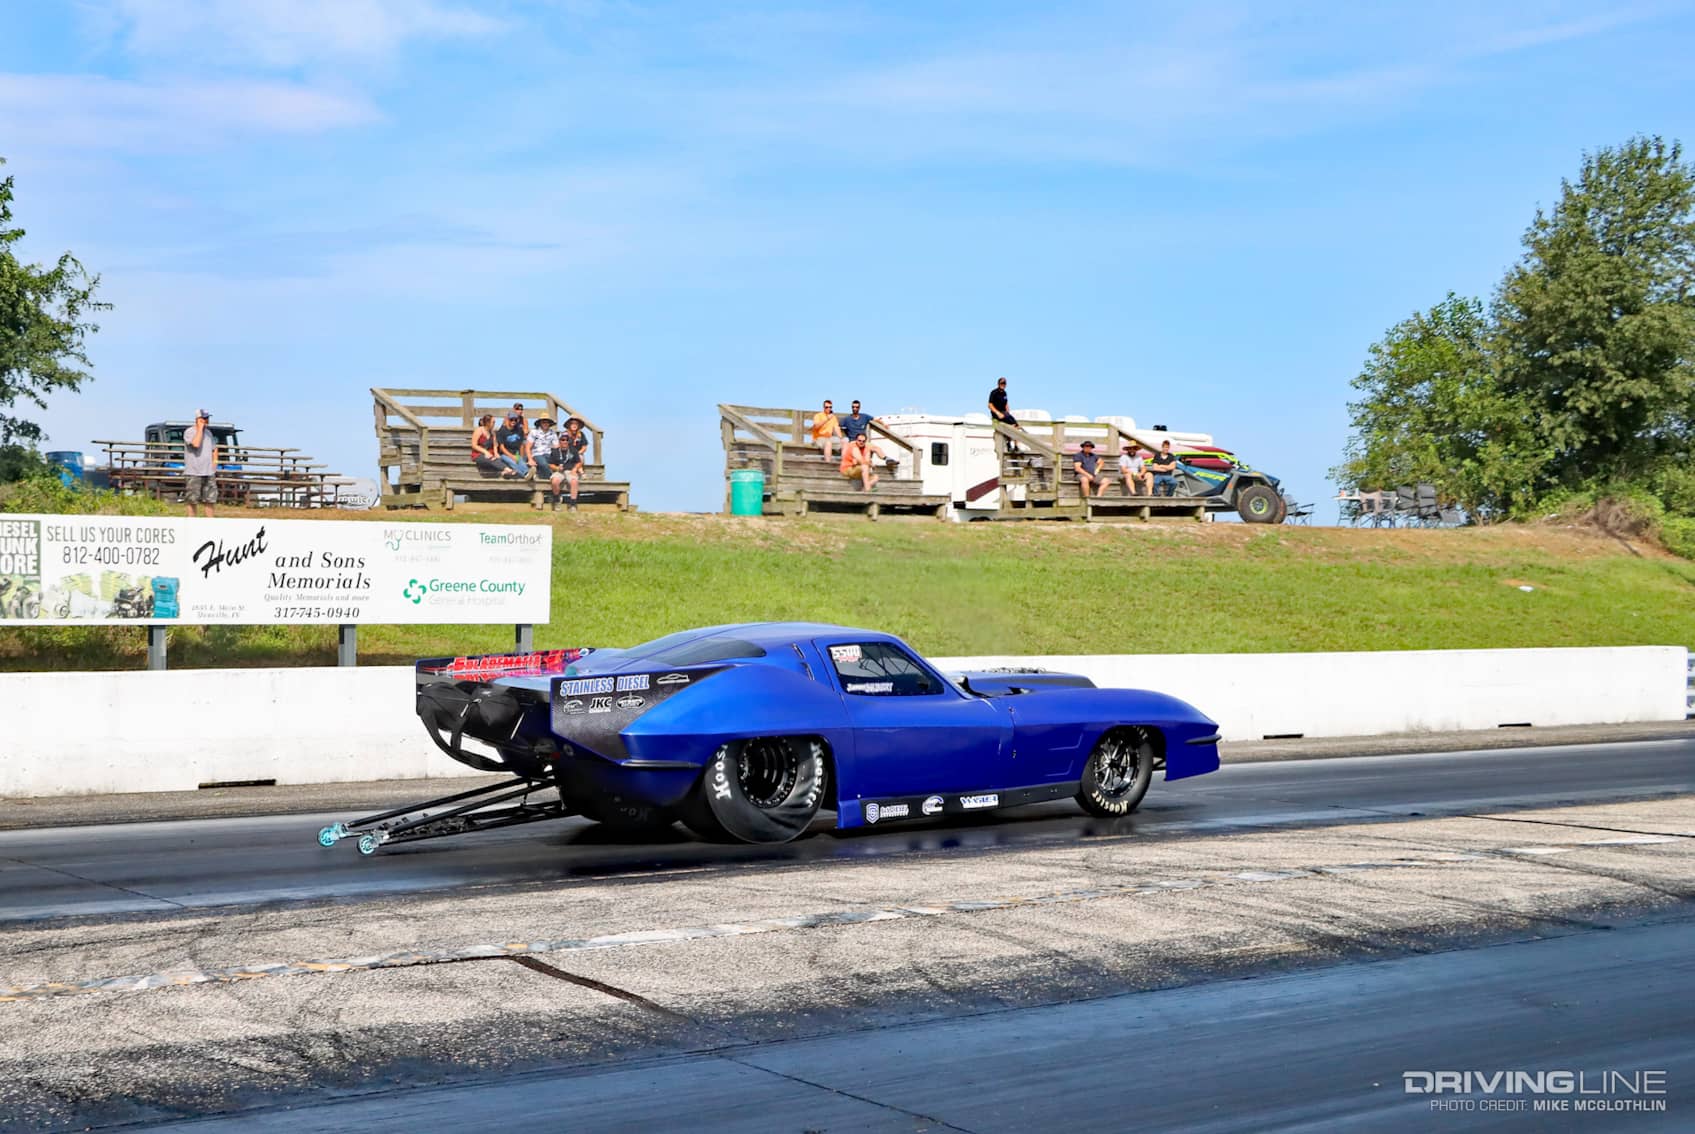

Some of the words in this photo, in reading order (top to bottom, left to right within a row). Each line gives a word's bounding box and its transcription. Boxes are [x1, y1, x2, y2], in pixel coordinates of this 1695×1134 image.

[47, 526, 77, 542] SELL
[80, 527, 96, 543] US
[100, 528, 132, 543] YOUR
[136, 528, 176, 544] CORES
[63, 546, 160, 565] 812-400-0782
[193, 525, 269, 579] Hunt
[275, 551, 313, 568] and
[321, 552, 366, 569] Sons
[267, 572, 371, 590] Memorials
[429, 578, 477, 592] Greene
[480, 578, 526, 596] County
[274, 607, 360, 619] 317-745-0940
[560, 677, 615, 696] STAINLESS
[616, 674, 651, 692] DIESEL
[590, 696, 613, 709] JKC
